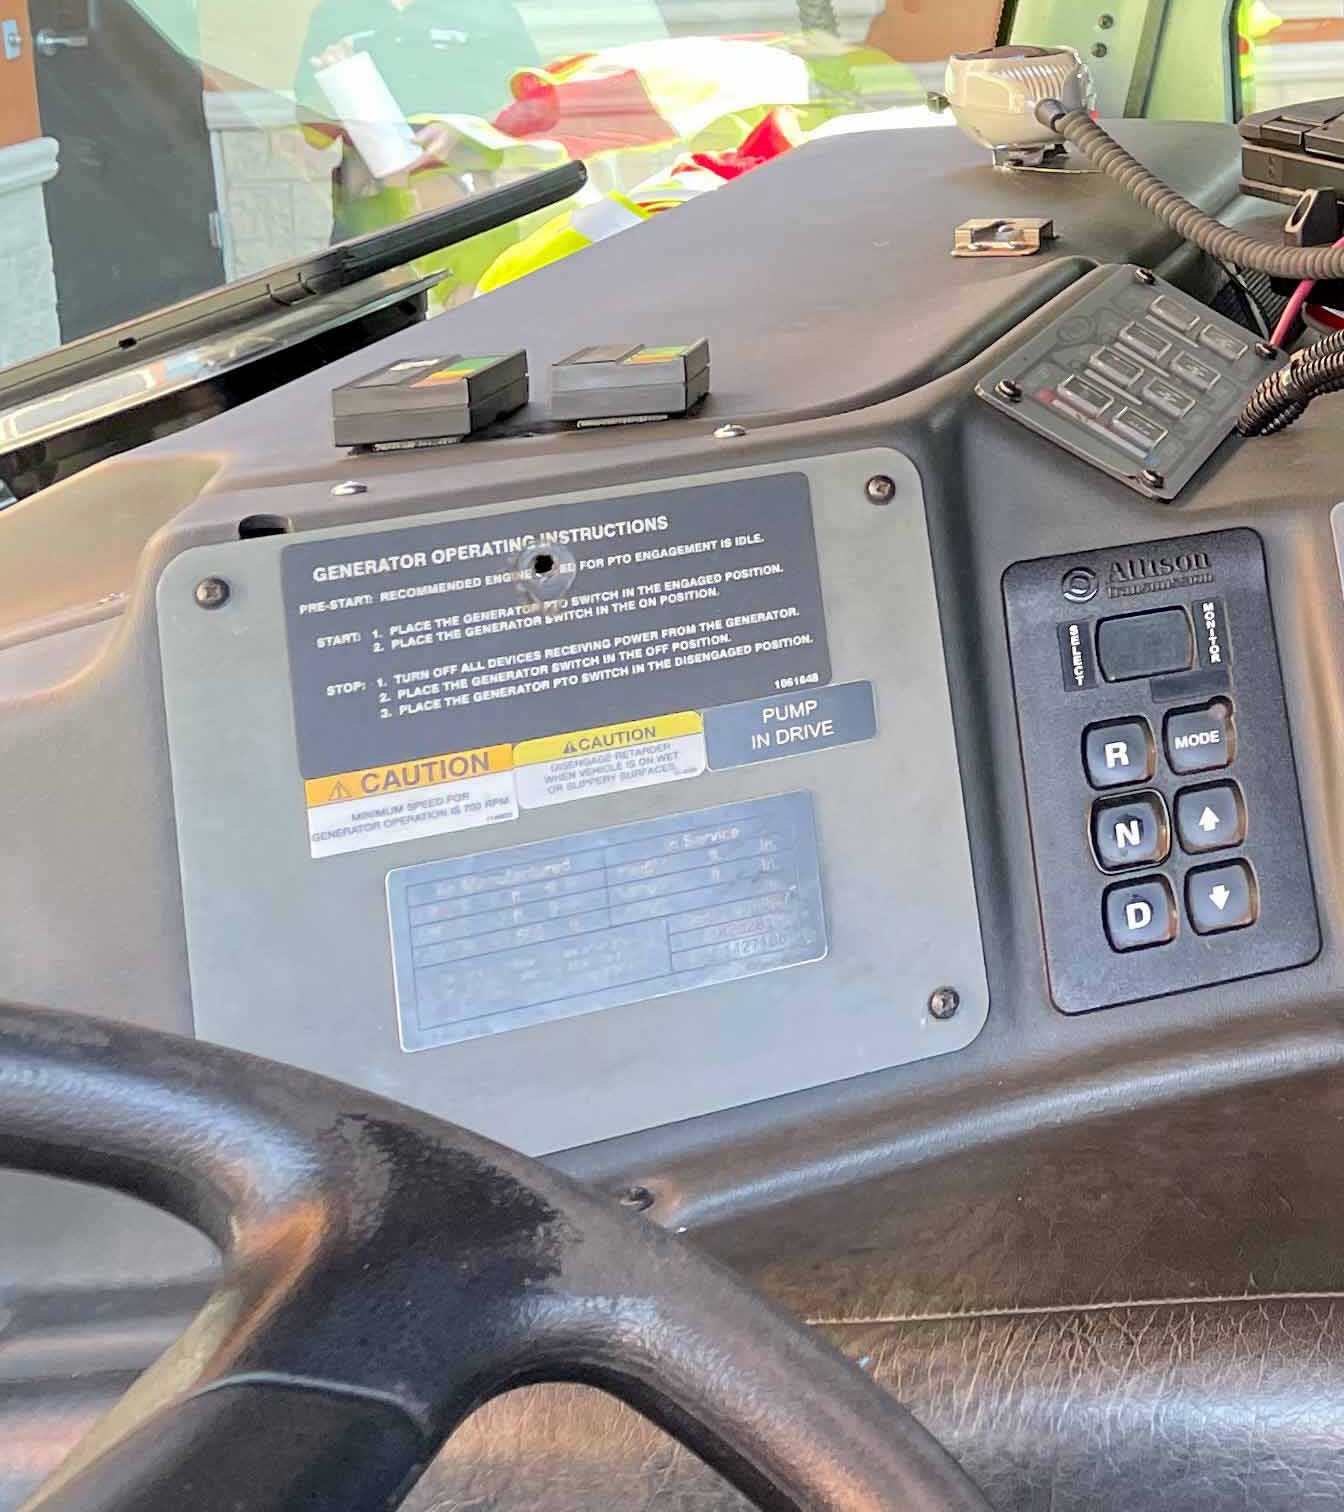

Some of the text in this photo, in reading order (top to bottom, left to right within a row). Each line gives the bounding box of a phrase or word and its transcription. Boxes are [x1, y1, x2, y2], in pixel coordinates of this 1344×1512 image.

[313, 515, 669, 581] GENERATOR OPERATING INSTRUCTIONS
[299, 595, 373, 613] PRE-START:
[380, 578, 482, 601] RECOMMENDED
[580, 558, 605, 570] FOR
[607, 553, 632, 566] PTO
[634, 541, 718, 561] ENGAGEMENT
[720, 538, 732, 548] IS
[735, 533, 765, 546] IDLE.
[1109, 552, 1212, 583] Allison
[316, 632, 361, 648] START:
[372, 629, 383, 639] 1.
[389, 620, 432, 635] PLACE
[434, 615, 460, 628] THE
[463, 604, 539, 623] GENERATOR
[571, 591, 619, 606] SWITCH
[622, 588, 635, 598] IN
[636, 583, 662, 595] THE
[664, 574, 722, 591] ENGAGED
[724, 564, 784, 580] POSITION.
[373, 588, 720, 653] 2. PLACE THE GENERATOR SWITCH IN THE ON POSITION.
[1202, 601, 1221, 664] MONITOR
[326, 607, 800, 696] STOP: 1. TURN OFF ALL DEVICES RECEIVING POWER FROM THE GENERATOR.
[1068, 624, 1085, 686] SELECT
[379, 634, 732, 703] 2. PLACE THE GENERATOR SWITCH IN THE OFF POSITION.
[380, 635, 814, 719] 3. PLACE THE GENERATOR PTO SWITCH IN THE DISENGAGED POSITION.
[762, 700, 818, 723] PUMP
[578, 726, 656, 751] CAUTION
[752, 720, 835, 749] IN DRIVE
[1174, 729, 1221, 750] MODE
[544, 772, 576, 784] WHEN
[579, 762, 623, 777] VEHICLE
[657, 751, 679, 762] WET
[550, 743, 671, 772] DISENGAGE RETARDER
[1104, 741, 1130, 769] R
[360, 751, 490, 793] CAUTION
[547, 784, 563, 794] OR
[566, 775, 616, 790] SLIPPERY
[619, 763, 675, 779] SURFACES
[312, 796, 510, 841] GENERATOR OPERATION IS RPM
[351, 792, 470, 821] MINIMUM SPEED FOR
[1114, 820, 1141, 849] N
[1125, 901, 1152, 930] D
